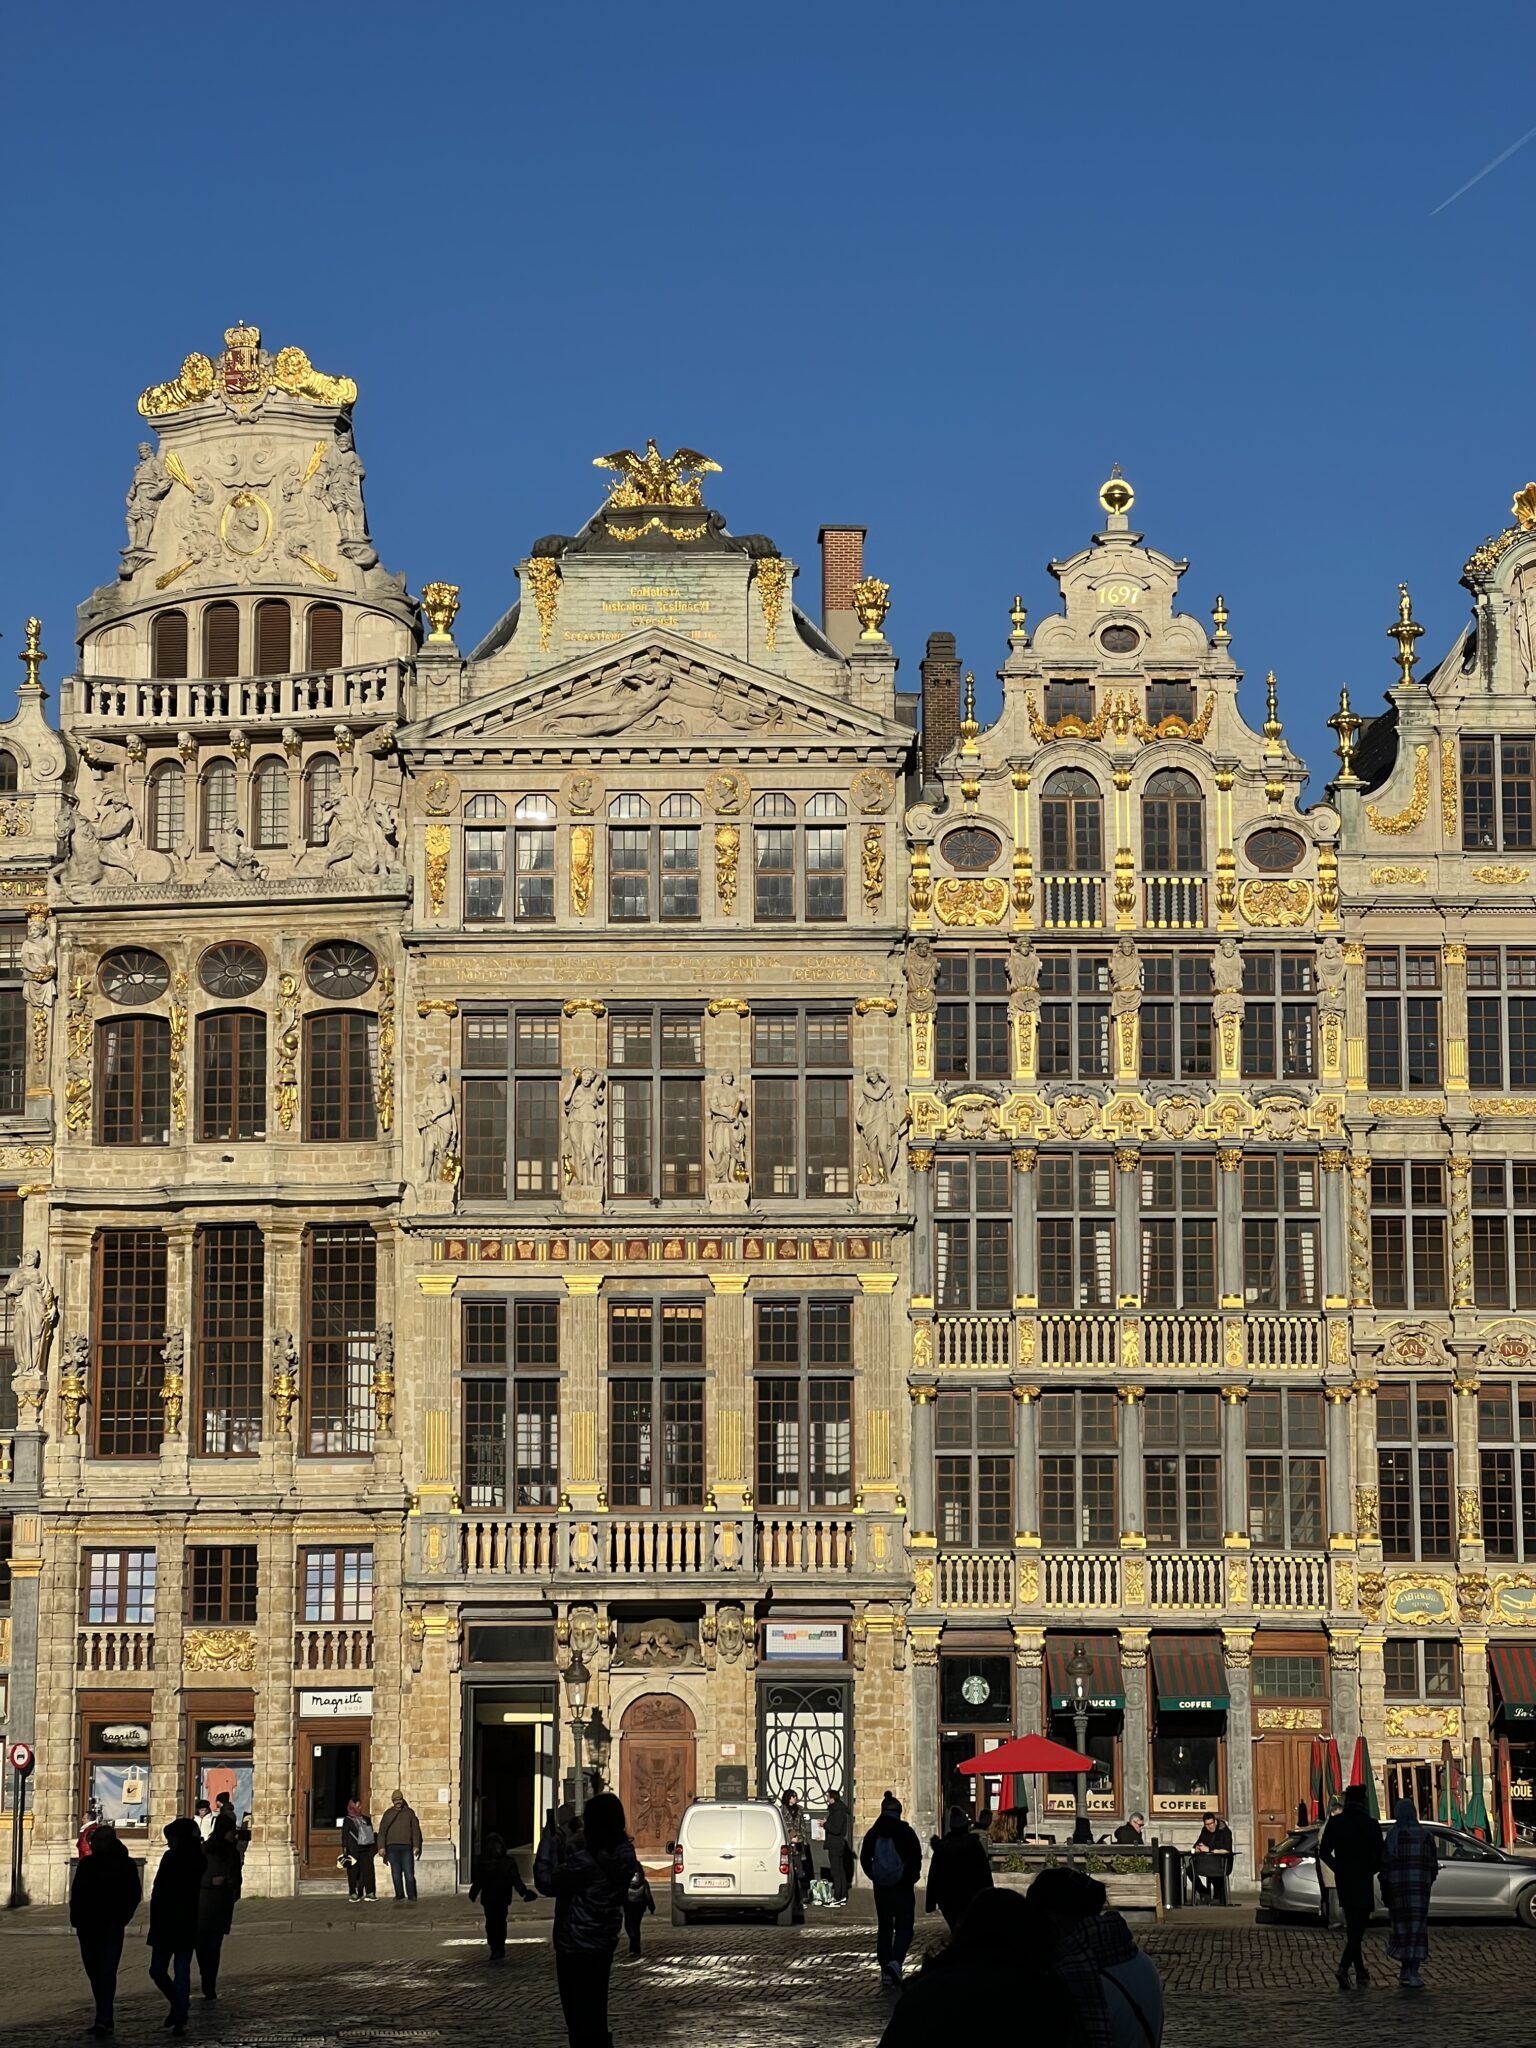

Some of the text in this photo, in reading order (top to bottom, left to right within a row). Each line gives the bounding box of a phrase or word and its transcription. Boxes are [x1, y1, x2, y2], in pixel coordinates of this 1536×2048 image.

[1099, 585, 1140, 604] 1697
[1048, 1800, 1116, 1809] TARUCKS
[1160, 1800, 1207, 1809] COFFEE
